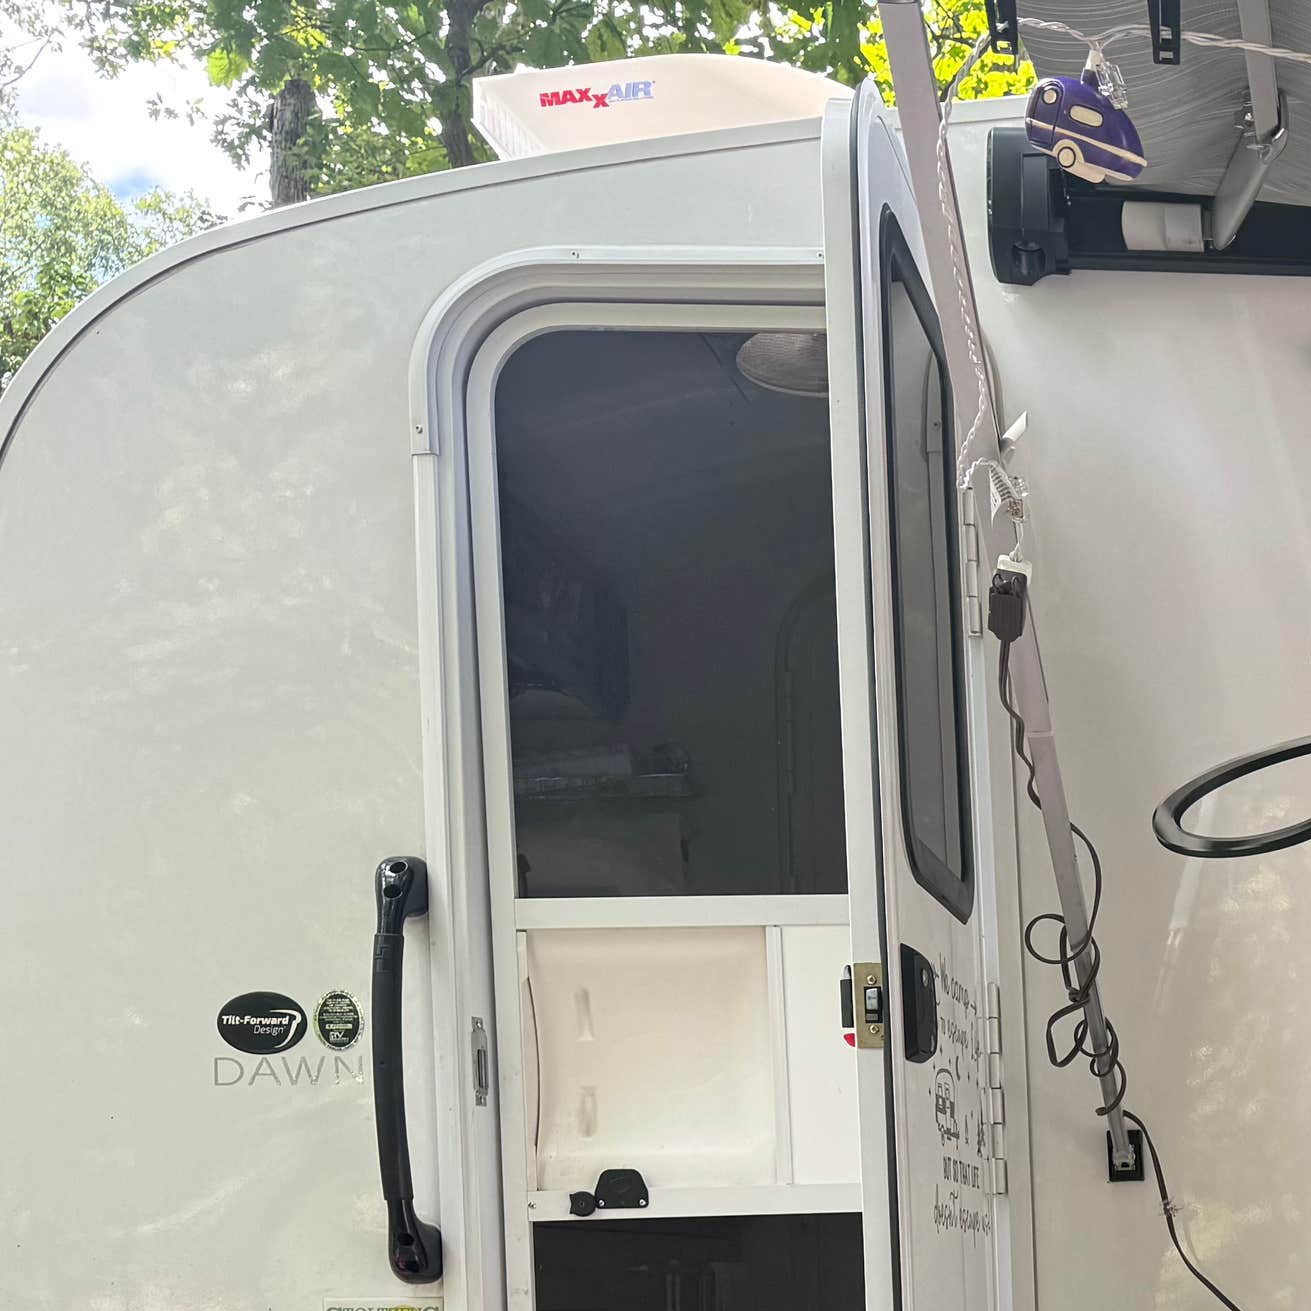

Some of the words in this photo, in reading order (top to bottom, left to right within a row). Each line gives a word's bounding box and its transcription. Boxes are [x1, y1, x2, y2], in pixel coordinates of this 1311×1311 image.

[221, 1014, 289, 1025] Tilt-Forward
[253, 1025, 284, 1036] Design
[213, 1055, 365, 1087] DAWN
